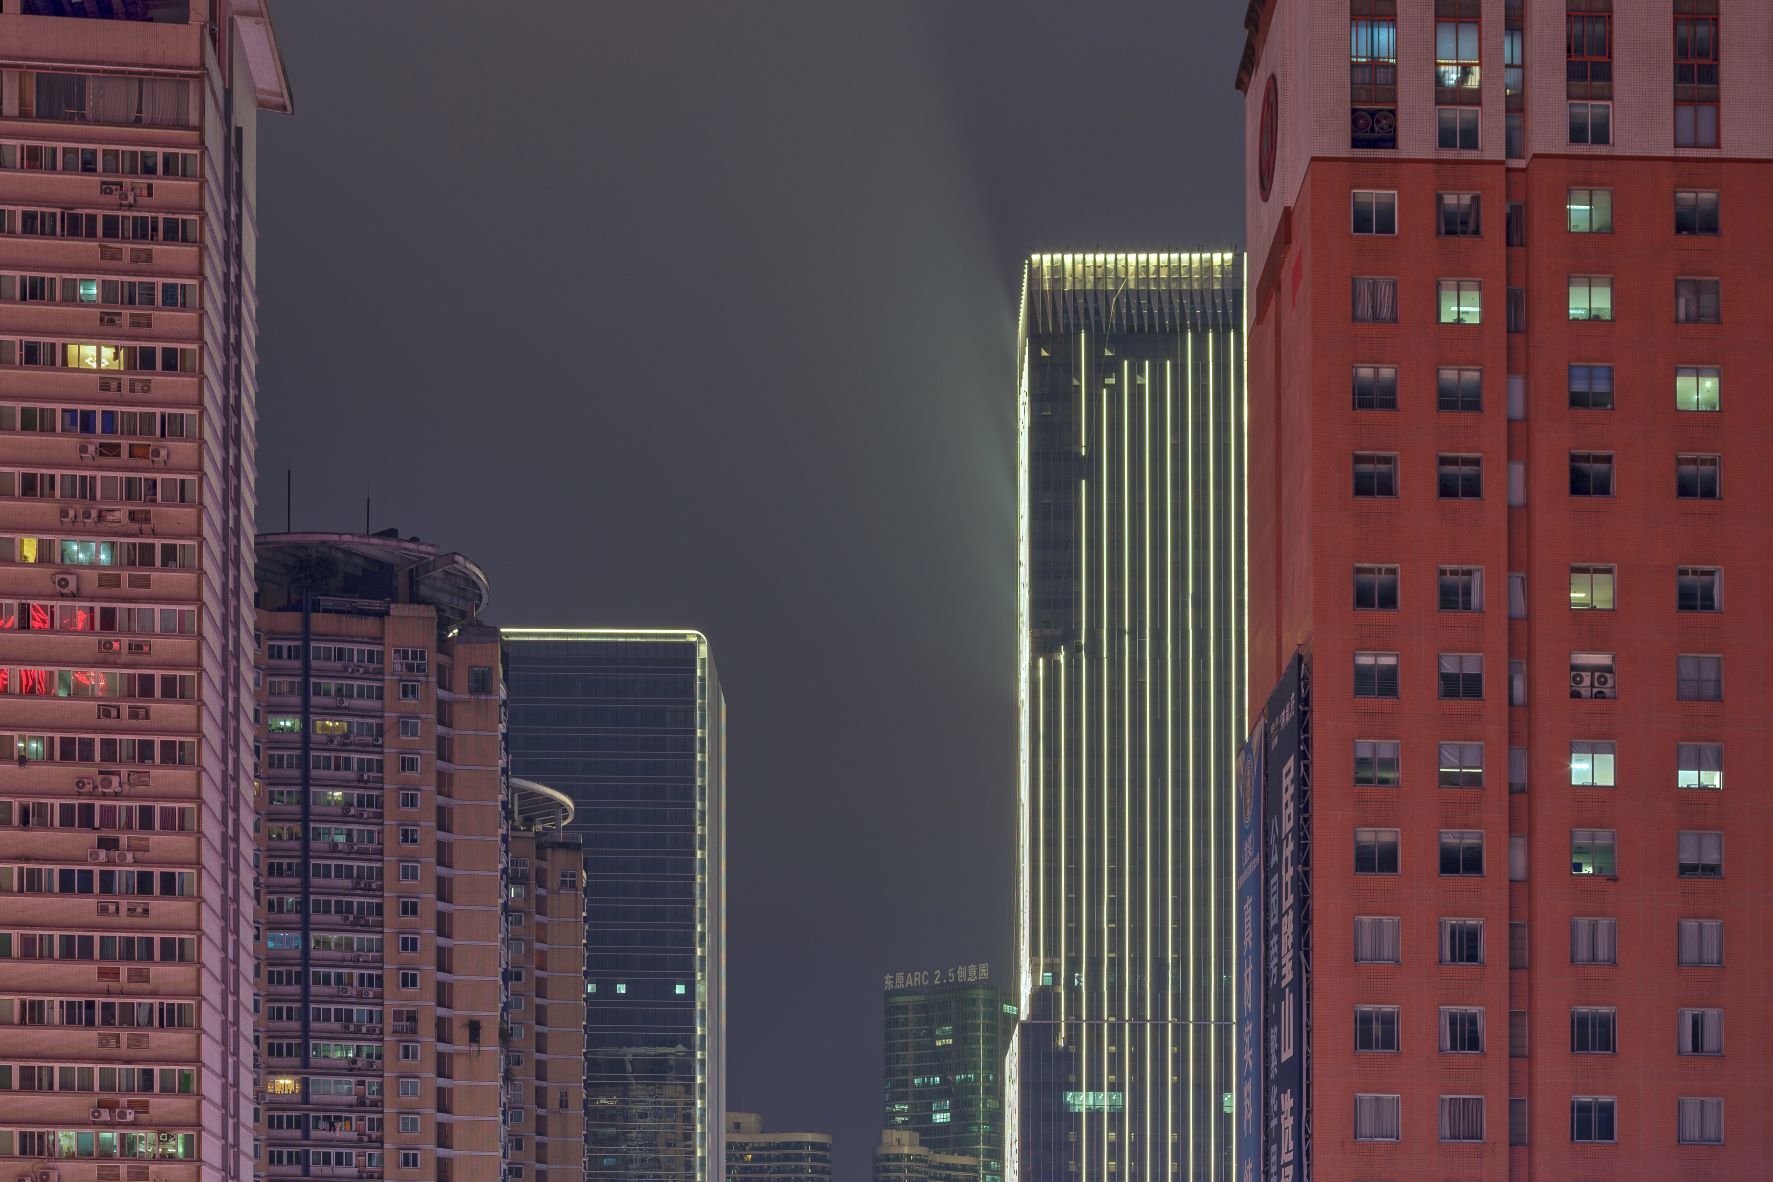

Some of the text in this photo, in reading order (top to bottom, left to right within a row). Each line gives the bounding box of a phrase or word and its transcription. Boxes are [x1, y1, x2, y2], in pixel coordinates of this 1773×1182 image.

[884, 963, 989, 990] 东原ARC 2.5创意园
[1243, 895, 1253, 1136] 真材实料
[1281, 753, 1295, 1063] 居住璧山
